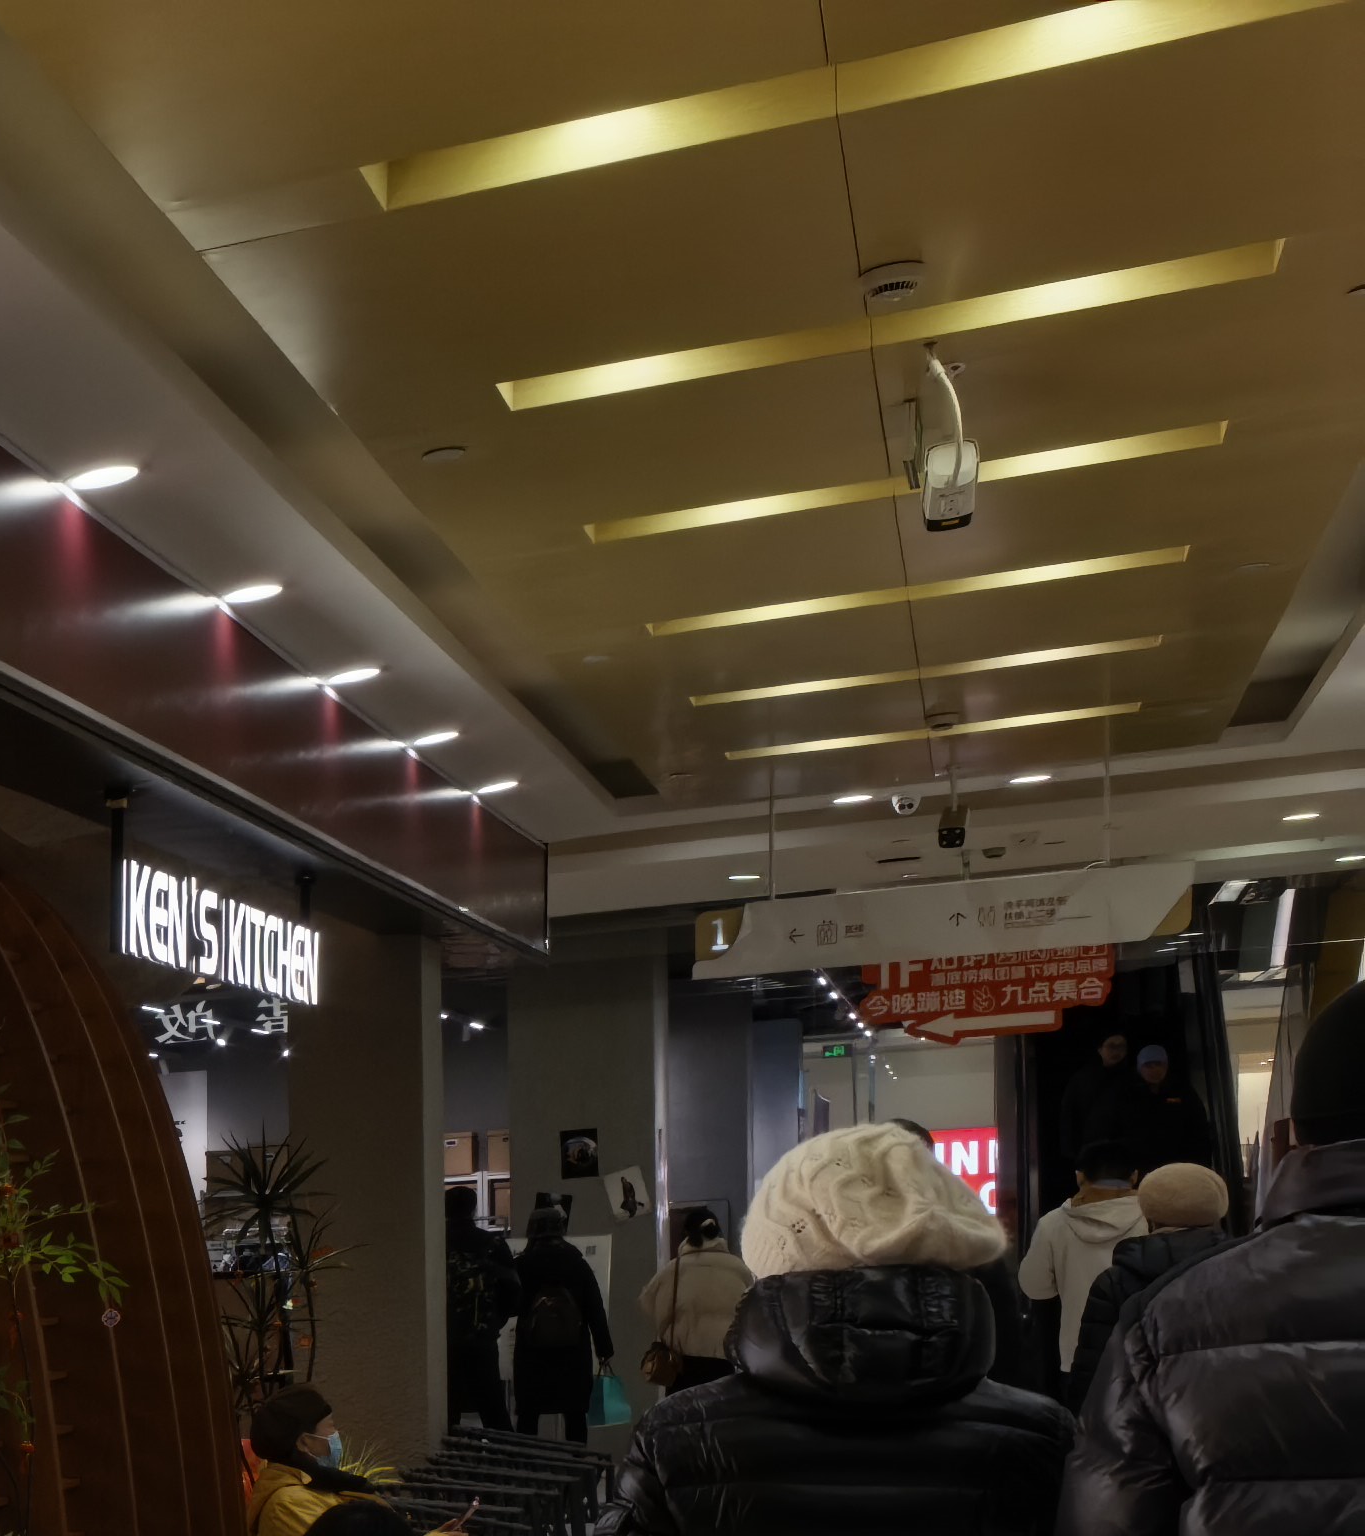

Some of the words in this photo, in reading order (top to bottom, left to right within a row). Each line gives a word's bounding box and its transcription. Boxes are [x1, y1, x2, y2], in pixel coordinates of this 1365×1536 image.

[122, 859, 219, 975] KEN'S
[221, 898, 319, 1005] KITCHEN
[1001, 977, 1105, 1006] 九点集合
